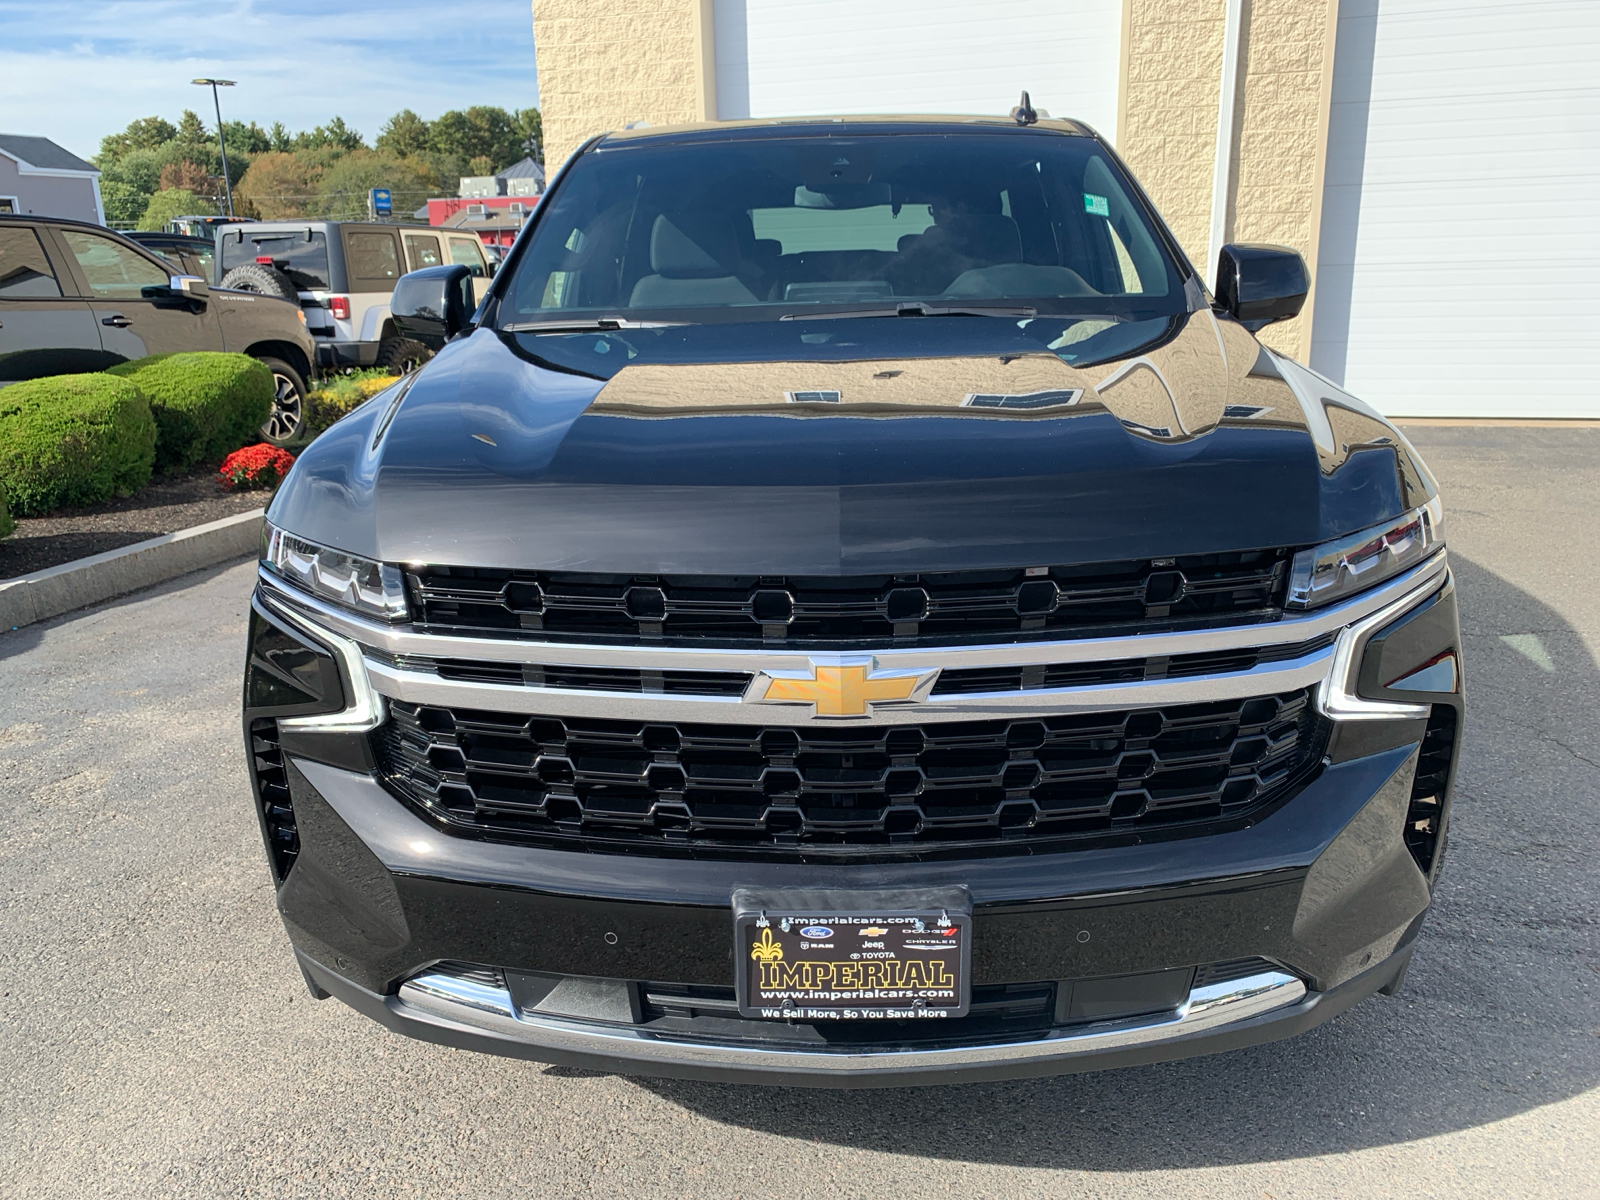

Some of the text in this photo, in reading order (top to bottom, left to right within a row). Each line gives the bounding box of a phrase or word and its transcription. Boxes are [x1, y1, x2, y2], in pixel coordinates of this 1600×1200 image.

[861, 940, 884, 950] Jeep
[861, 951, 896, 959] TOYOTA
[759, 960, 954, 989] IMPERIAL
[760, 989, 954, 1001] www.imperialcars.com
[761, 1009, 947, 1020] We Sell More, So You Save More
